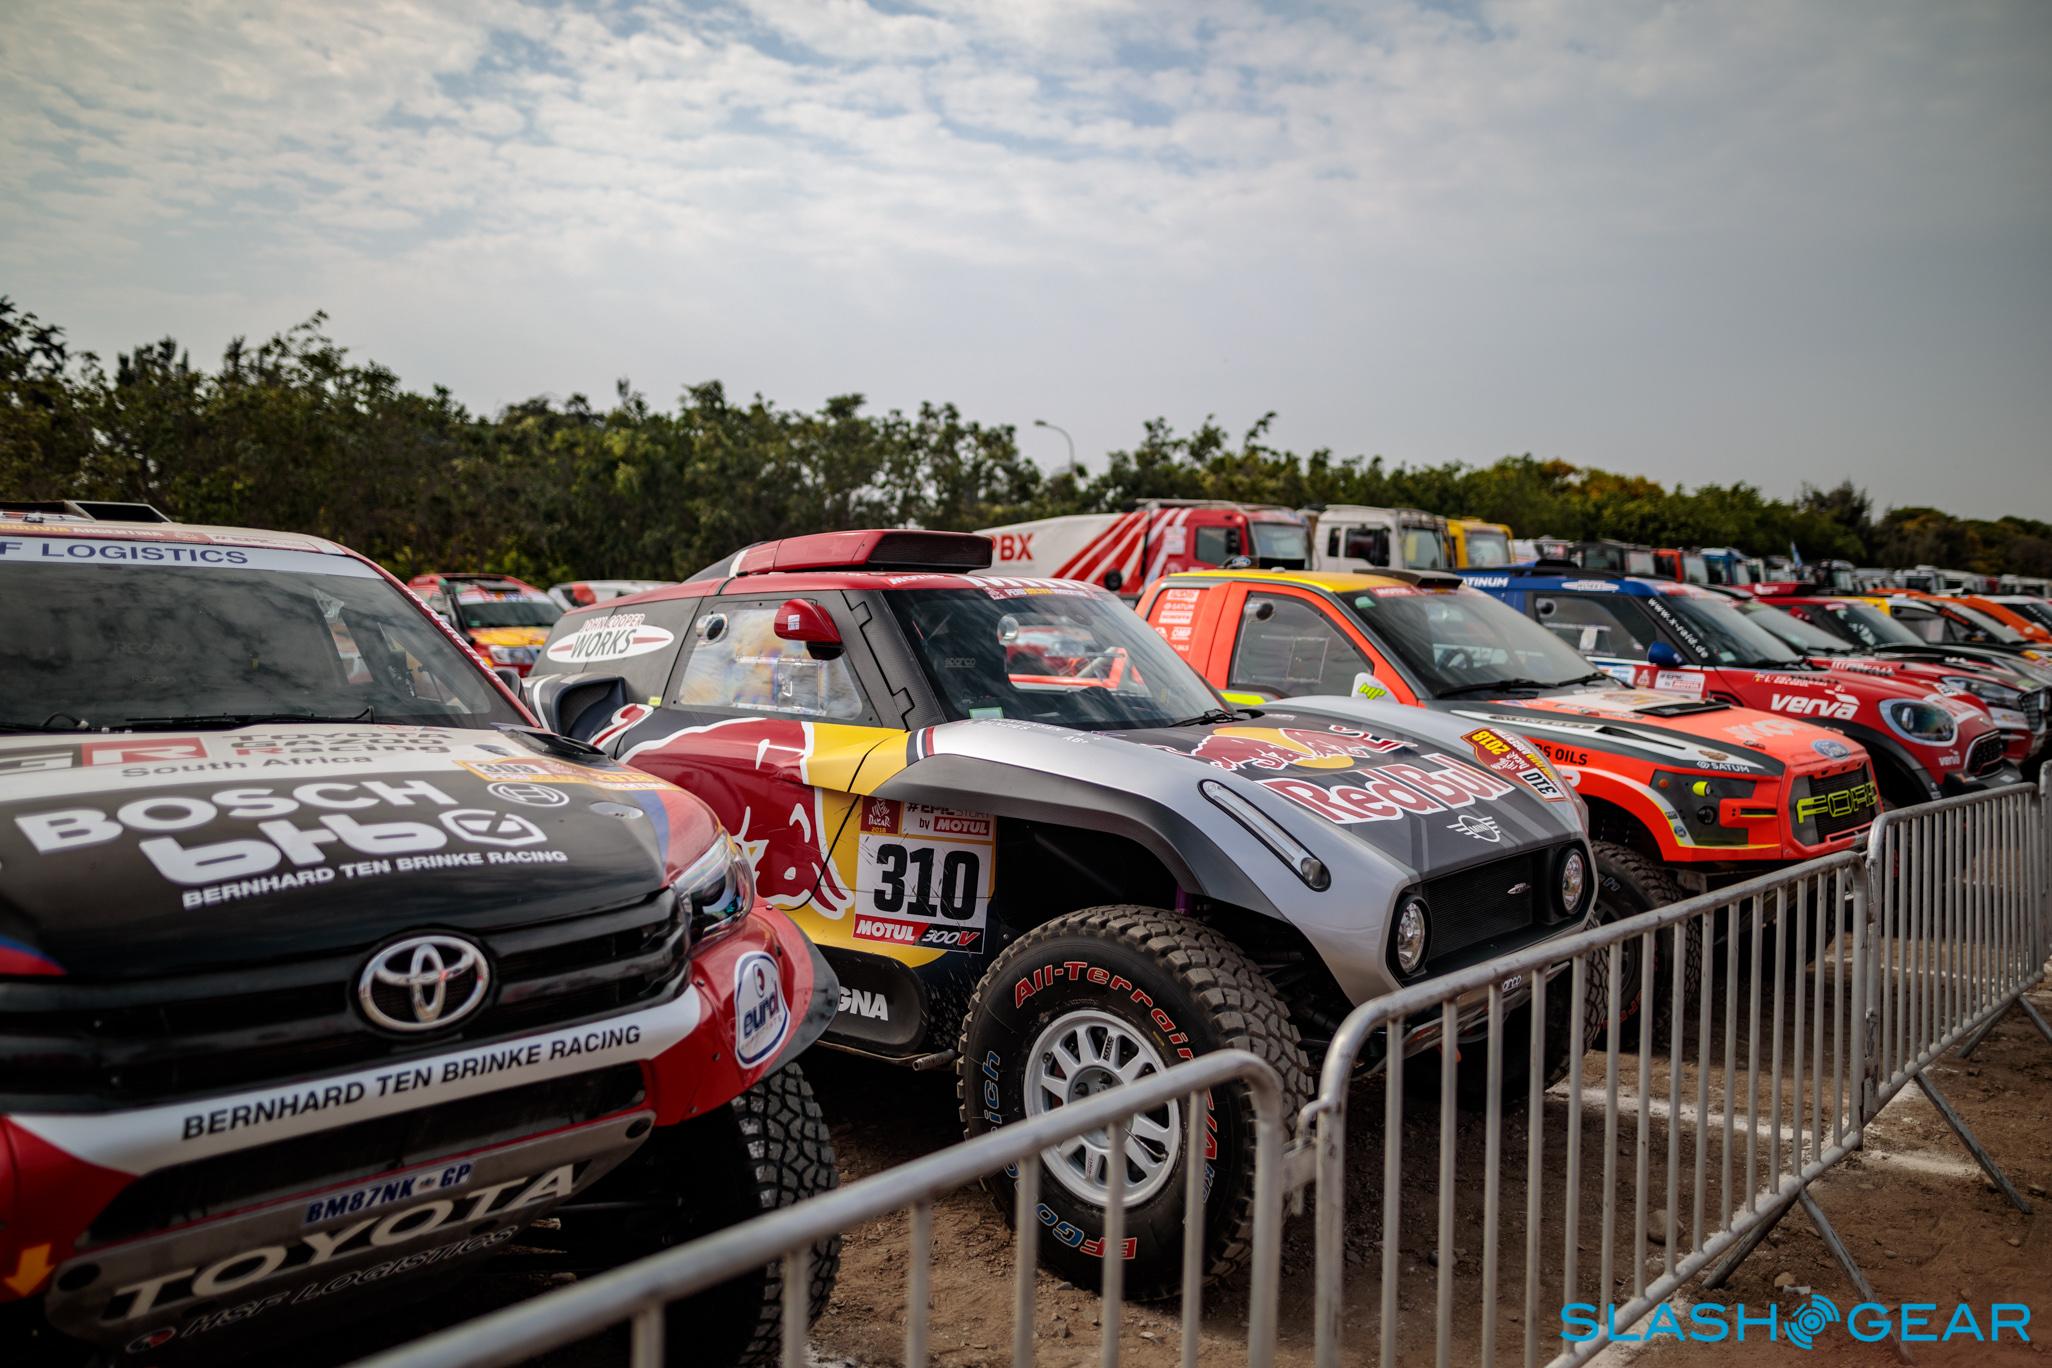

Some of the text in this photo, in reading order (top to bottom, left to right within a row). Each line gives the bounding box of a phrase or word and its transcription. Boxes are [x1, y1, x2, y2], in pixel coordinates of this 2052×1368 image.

[41, 543, 249, 564] LOGISTICS
[1462, 576, 1509, 588] ATINUM
[570, 629, 637, 659] WORKS
[1770, 693, 1859, 720] verva
[222, 732, 453, 742] TOYOTA
[231, 738, 443, 748] GAZOO
[236, 743, 451, 755] Racing
[1471, 731, 1511, 755] 2018
[122, 756, 373, 777] South Africa
[1555, 749, 1589, 766] OILS
[1711, 761, 1750, 773] SATUM
[1522, 772, 1557, 794] 310
[15, 780, 458, 854] BOSCH
[868, 815, 891, 828] DAKAR
[920, 818, 988, 834] by MOTUL
[182, 850, 568, 911] BERNHARD TEN BRINKE RACING
[874, 843, 980, 921] 310
[855, 919, 980, 946] MOTUL 300V
[1015, 961, 1194, 1064] All-Terrain
[181, 1024, 640, 1142] BERNHARD TEN BRINKE RACING
[305, 1163, 472, 1224] BM87NK GP
[115, 1163, 577, 1320] TOYOTA
[292, 1225, 518, 1304] LOGISTICS
